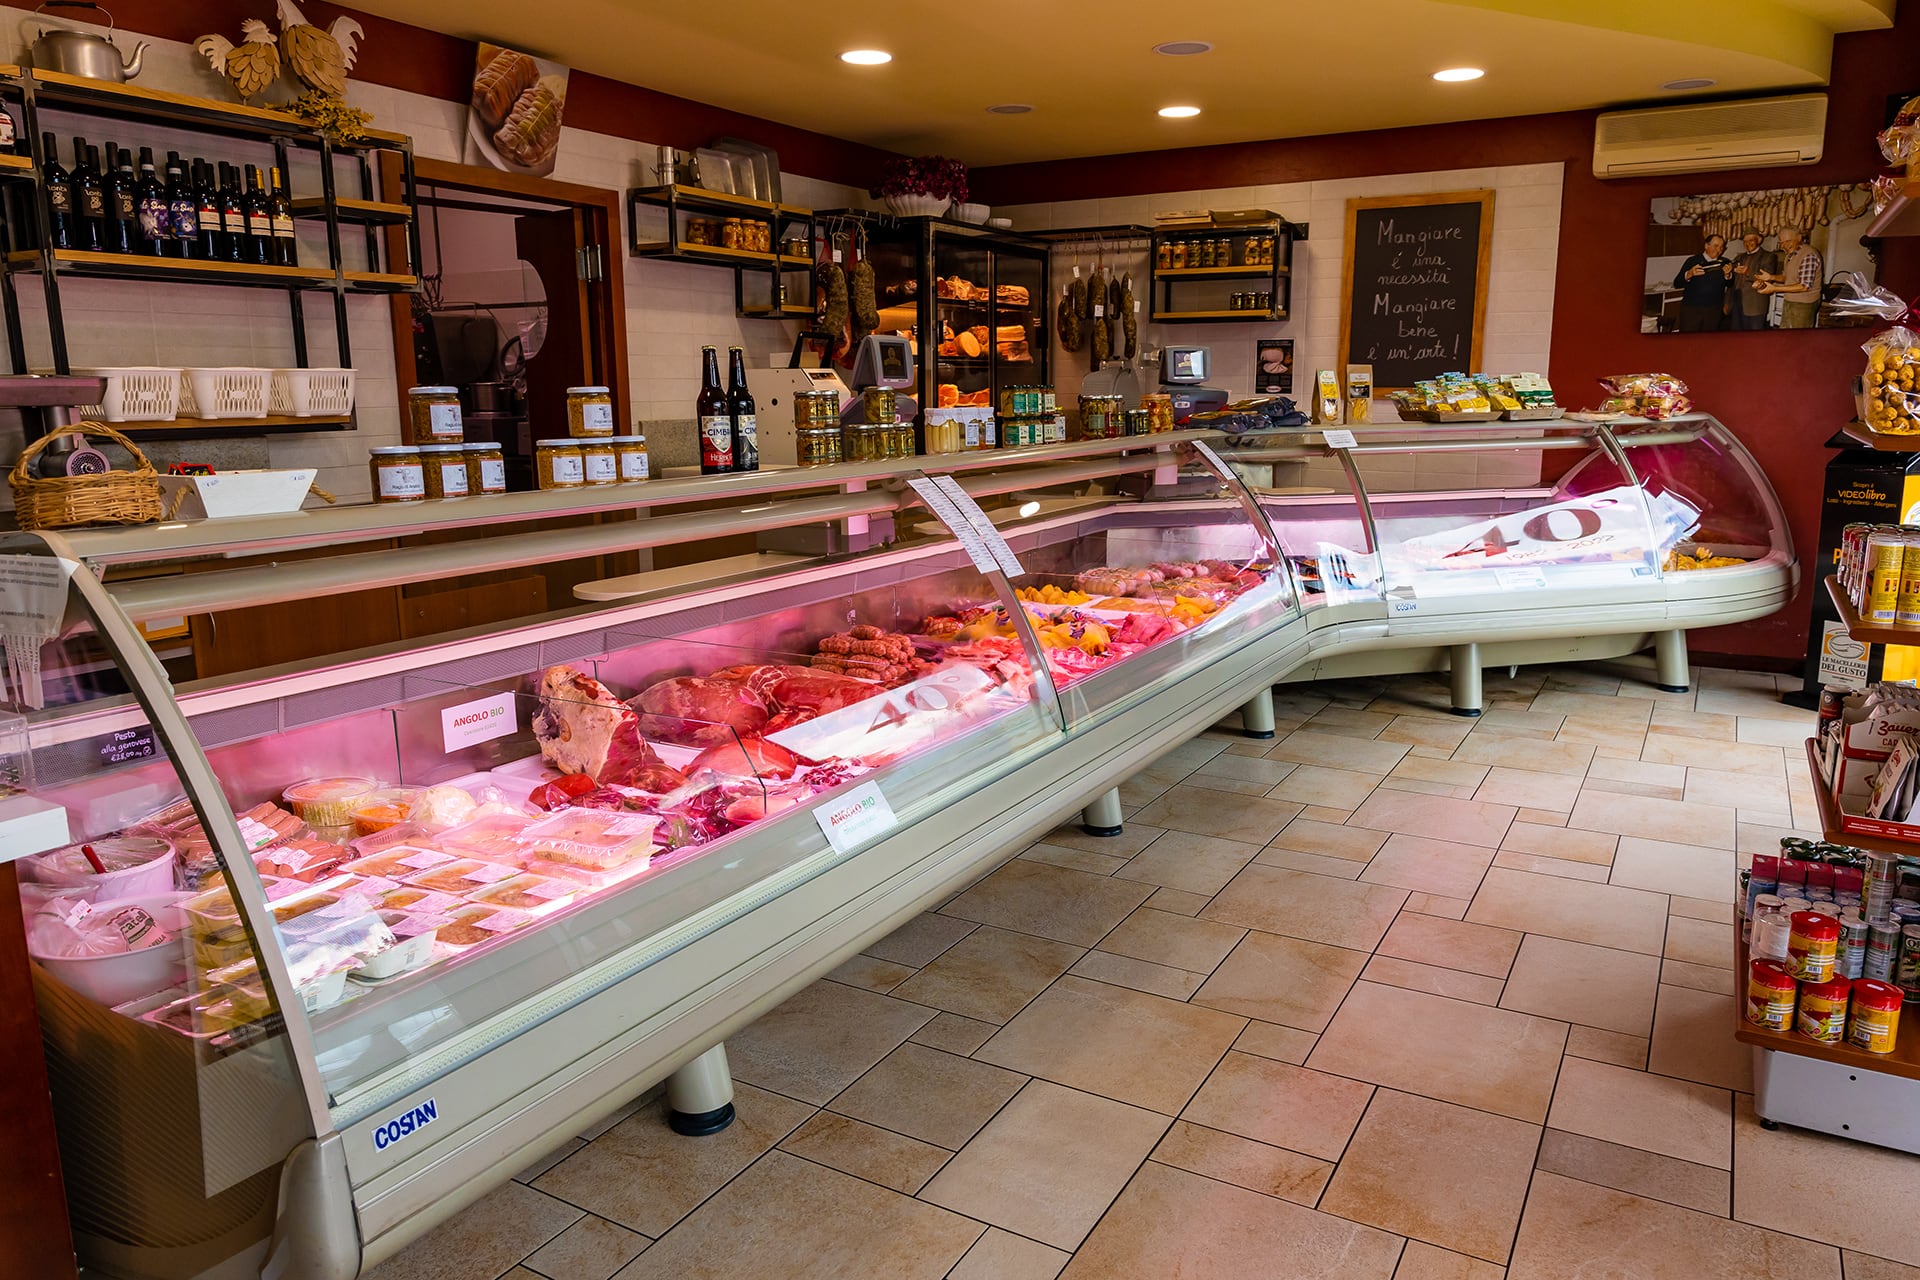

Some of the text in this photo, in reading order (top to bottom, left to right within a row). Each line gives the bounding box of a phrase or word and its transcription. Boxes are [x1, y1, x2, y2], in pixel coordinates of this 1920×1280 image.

[1377, 218, 1464, 256] Mangiare
[1412, 254, 1448, 268] una
[1373, 292, 1457, 323] Mangiare
[1397, 320, 1438, 338] bene
[1821, 662, 1867, 677] DEL GUSTO
[453, 706, 505, 728] ANGOLO BIO
[100, 737, 152, 755] alla genovese
[114, 730, 136, 742] Pesto
[829, 803, 863, 827] ANGOLO
[861, 795, 876, 809] BIO
[375, 1099, 437, 1149] COSTAN
